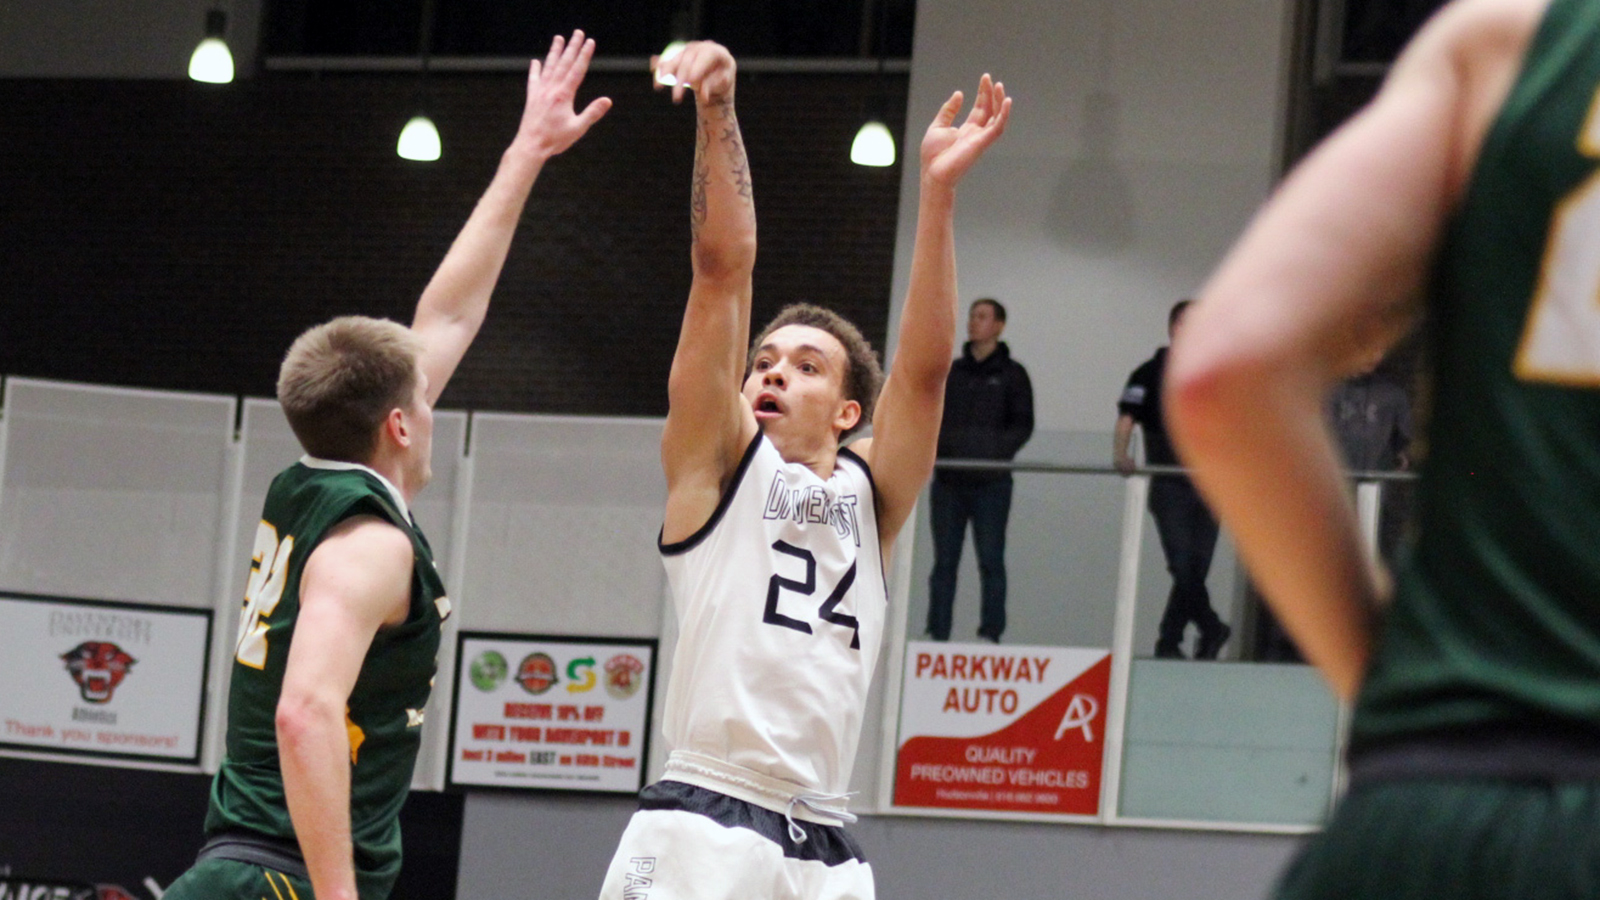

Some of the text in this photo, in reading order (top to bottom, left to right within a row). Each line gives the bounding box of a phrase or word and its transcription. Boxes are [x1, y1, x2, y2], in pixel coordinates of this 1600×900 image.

[763, 539, 860, 650] 24
[915, 653, 1051, 683] PARKWAY
[943, 687, 1019, 714] AUTO
[5, 719, 54, 738] Thank
[62, 729, 91, 744] you
[530, 751, 556, 765] EAST
[965, 745, 1036, 764] QUALITY
[910, 764, 1089, 788] PREOWNED VEHICLES
